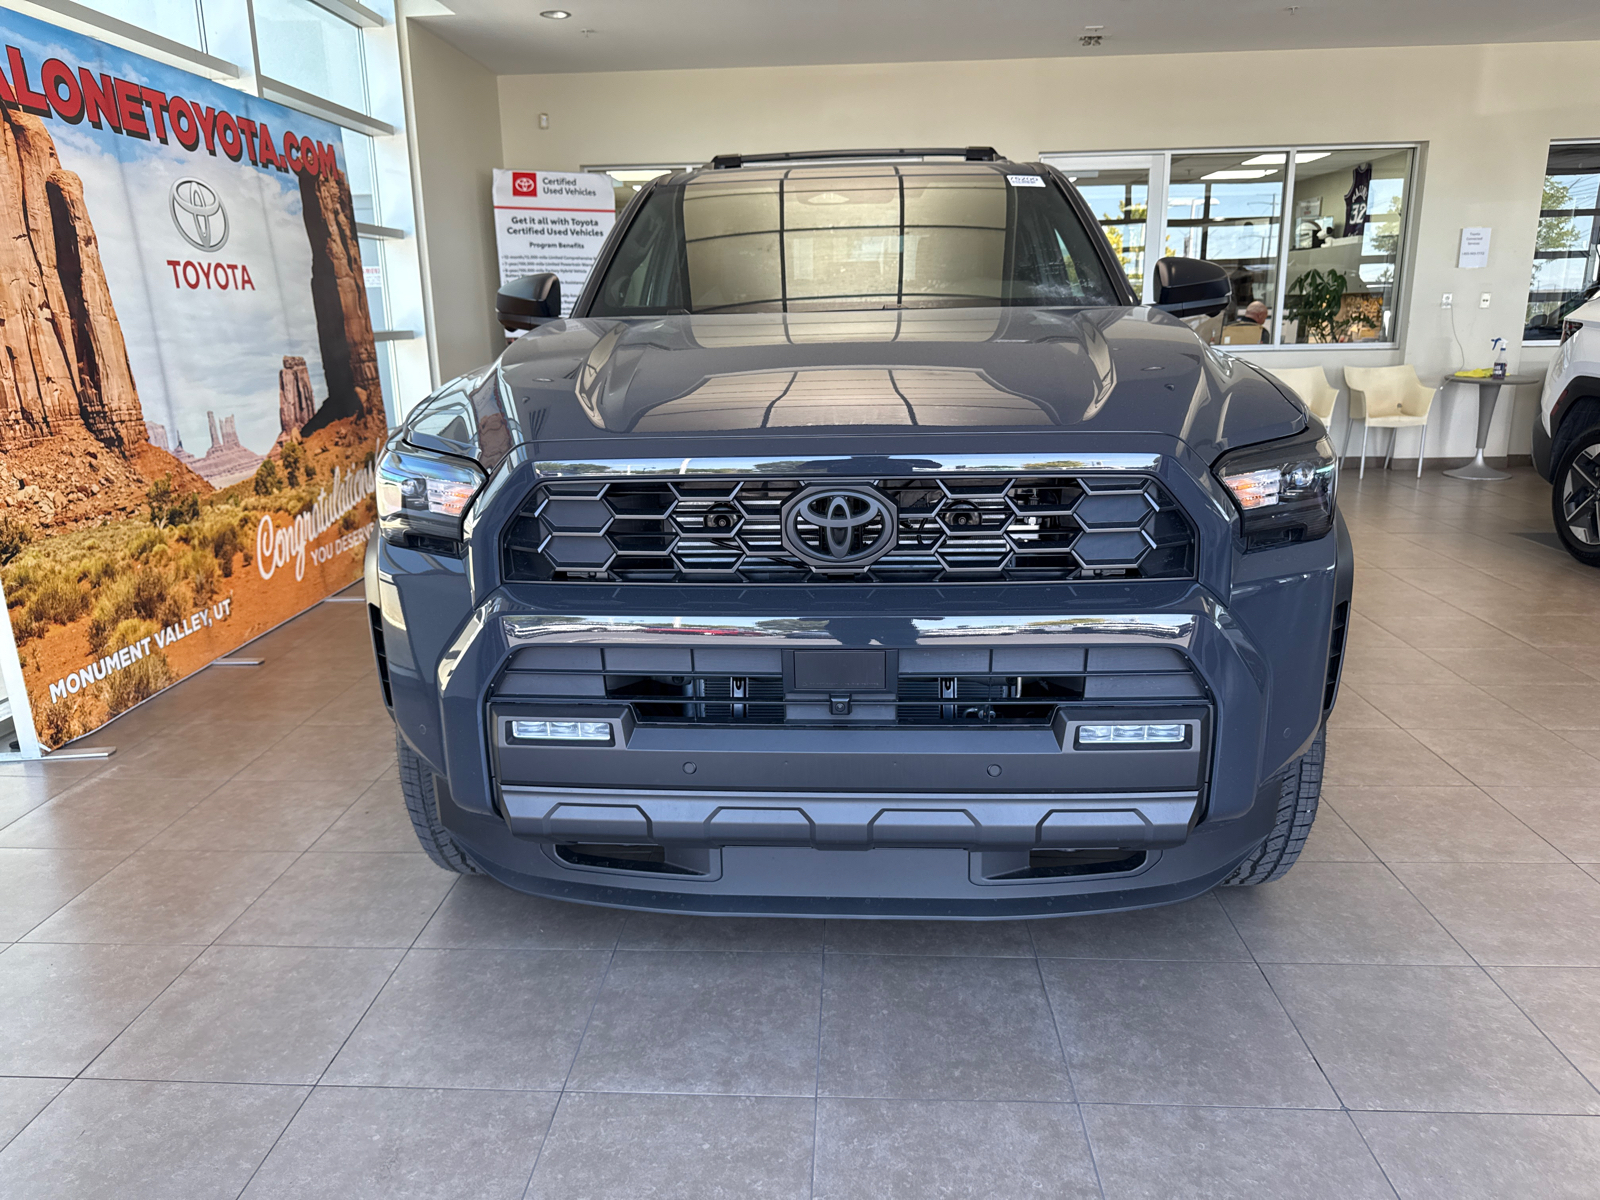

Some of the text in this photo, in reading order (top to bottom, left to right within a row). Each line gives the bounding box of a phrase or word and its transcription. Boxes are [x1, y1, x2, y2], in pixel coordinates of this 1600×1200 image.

[542, 177, 577, 186] Certified
[543, 186, 597, 197] Used Vehicles
[1349, 203, 1367, 224] 32
[511, 216, 599, 228] Get it all with Toyota
[506, 226, 604, 237] Certified Used Vehicles
[529, 242, 557, 250] Program
[167, 259, 256, 291] TOYOTA
[310, 542, 334, 566] YOU
[49, 598, 232, 704] MONUMENT VALLEY, UT
